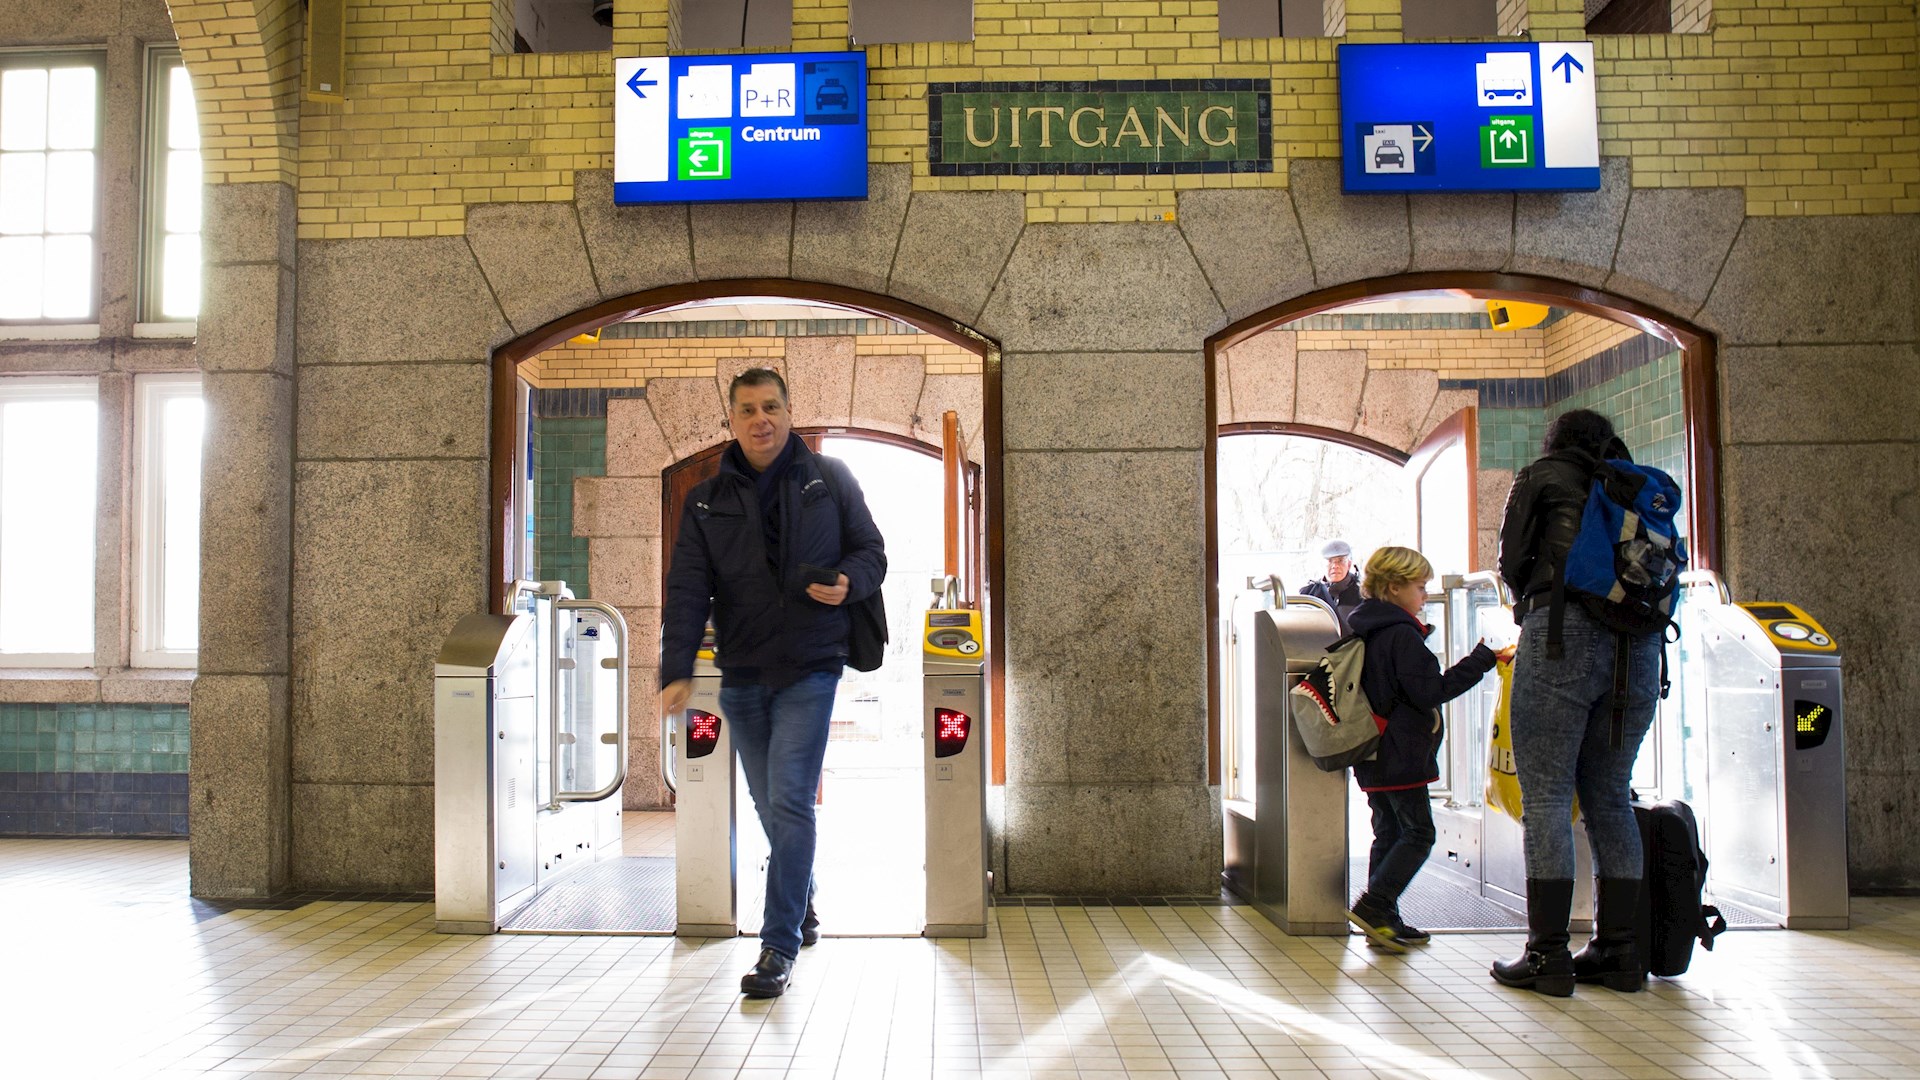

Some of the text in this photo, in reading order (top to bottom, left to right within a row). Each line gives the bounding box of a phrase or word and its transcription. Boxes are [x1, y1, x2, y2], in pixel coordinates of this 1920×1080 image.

[745, 88, 791, 109] P+R
[962, 105, 1237, 148] UITGANG
[1491, 118, 1515, 126] uitgang
[741, 126, 820, 142] Centrum
